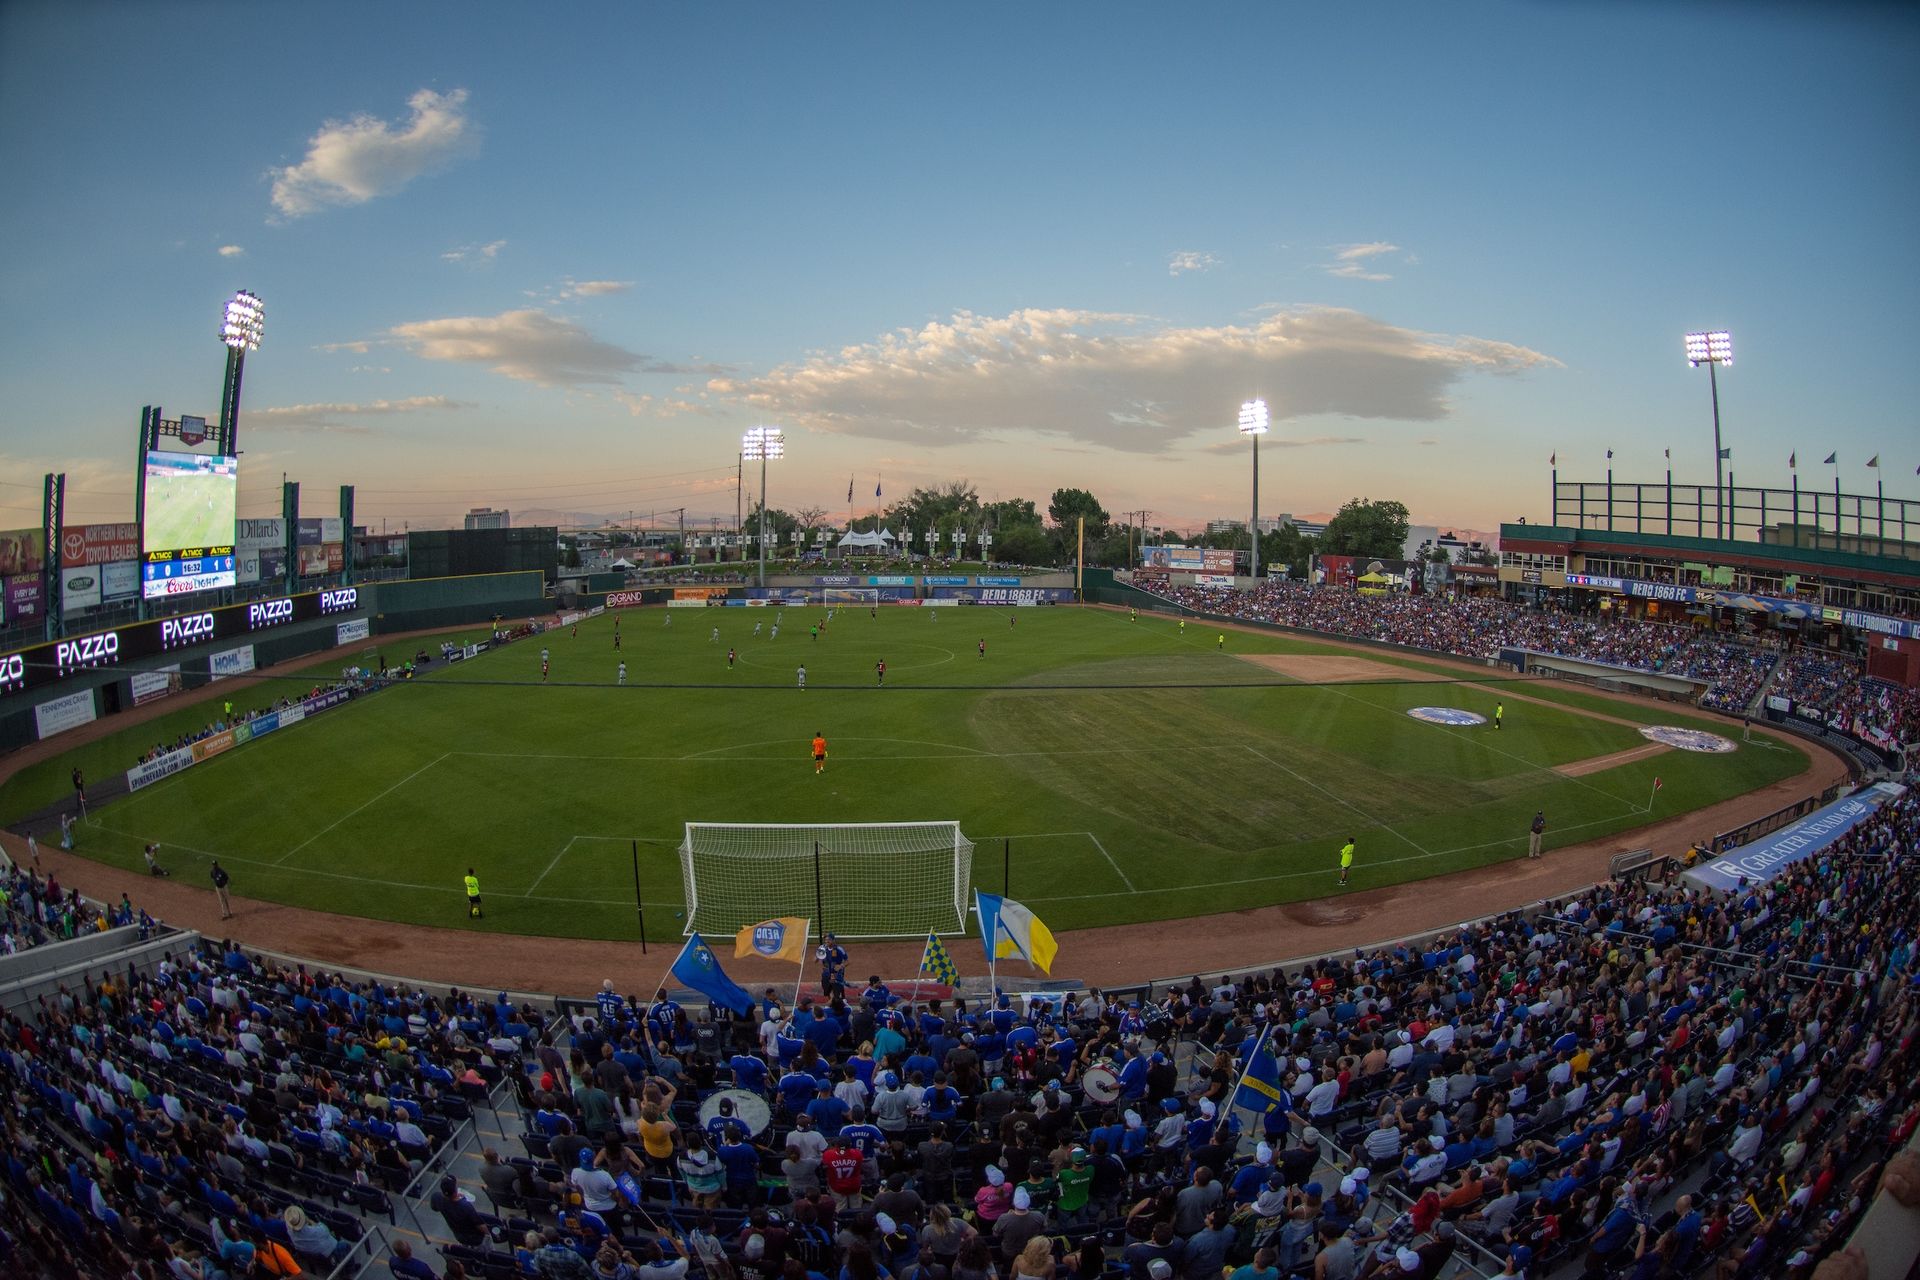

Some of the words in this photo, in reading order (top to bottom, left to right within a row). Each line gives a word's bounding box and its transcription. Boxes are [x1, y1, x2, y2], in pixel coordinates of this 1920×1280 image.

[85, 525, 115, 542] NORTHERN
[117, 524, 138, 540] NEVADA
[240, 519, 280, 539] Dillard's
[85, 546, 109, 563] TOYOTA
[111, 544, 138, 560] DEALERS
[165, 564, 171, 577] 0
[183, 563, 201, 573] 16:32
[244, 559, 258, 574] IGT
[167, 578, 194, 593] Coors
[982, 588, 1006, 600] RENO
[1008, 589, 1031, 600] 1868
[1033, 590, 1045, 600] FC
[1632, 582, 1653, 597] RENO
[1654, 585, 1675, 600] 1868
[1675, 587, 1687, 601] FC
[322, 588, 357, 608] PAZZO
[616, 591, 642, 603] GRAND
[250, 599, 293, 622] PAZZO
[162, 613, 214, 641] PAZZO
[1845, 612, 1903, 636] #ALLFOROURCITY
[57, 632, 118, 666] PAZZO
[59, 655, 119, 677] SPORTS
[41, 698, 73, 714] FENNEMORE
[73, 694, 89, 705] CRAIG
[1740, 834, 1812, 871] GREATER
[1803, 812, 1847, 839] NEVADA
[831, 1159, 857, 1168] CHAPO
[836, 1167, 854, 1179] 17
